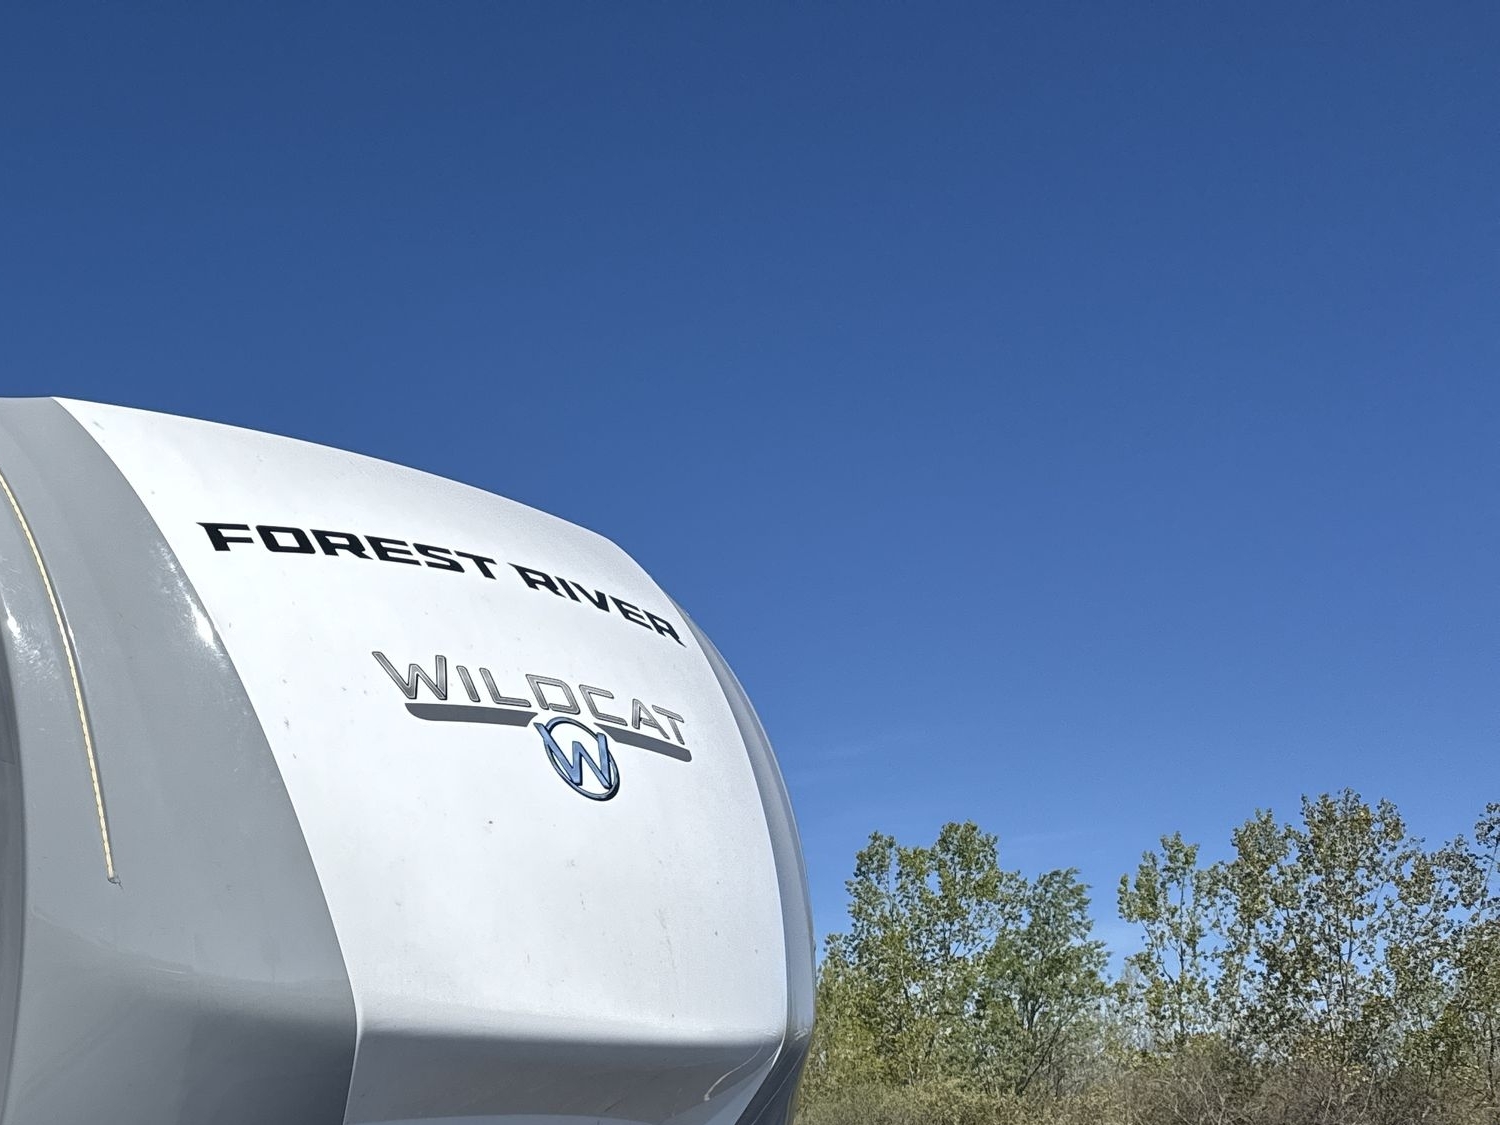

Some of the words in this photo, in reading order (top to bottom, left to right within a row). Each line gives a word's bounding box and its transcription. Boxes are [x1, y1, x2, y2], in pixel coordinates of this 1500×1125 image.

[197, 522, 497, 580] FOREST
[508, 562, 686, 647] RIVER
[371, 650, 686, 746] WILDCAT
[534, 721, 613, 791] W
